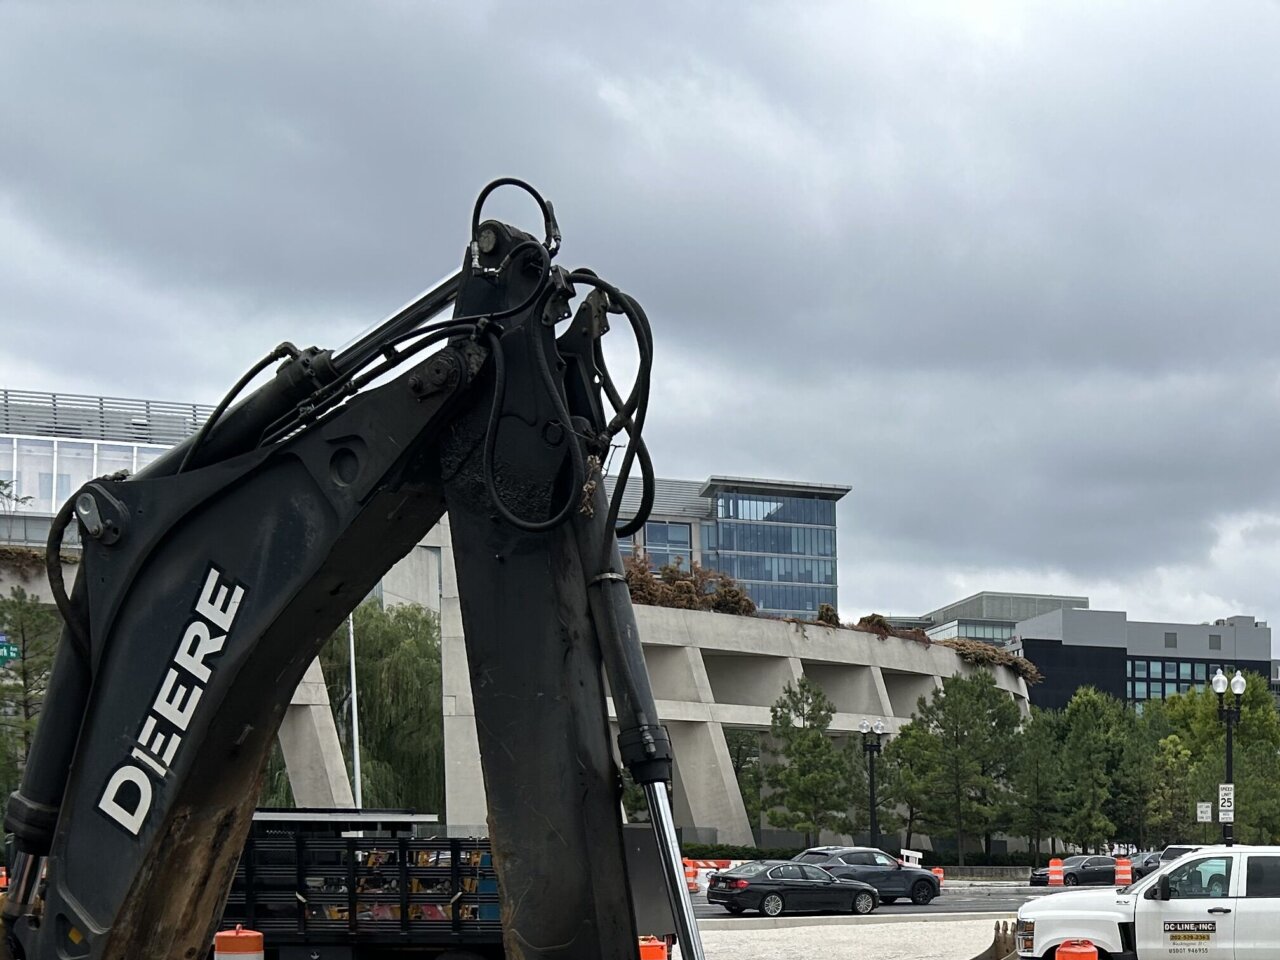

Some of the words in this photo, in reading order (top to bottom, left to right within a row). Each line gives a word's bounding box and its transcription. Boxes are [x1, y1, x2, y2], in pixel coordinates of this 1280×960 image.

[98, 568, 245, 835] DEERE
[1220, 798, 1233, 808] 25
[1164, 923, 1175, 931] DC
[1177, 923, 1197, 931] LINE,
